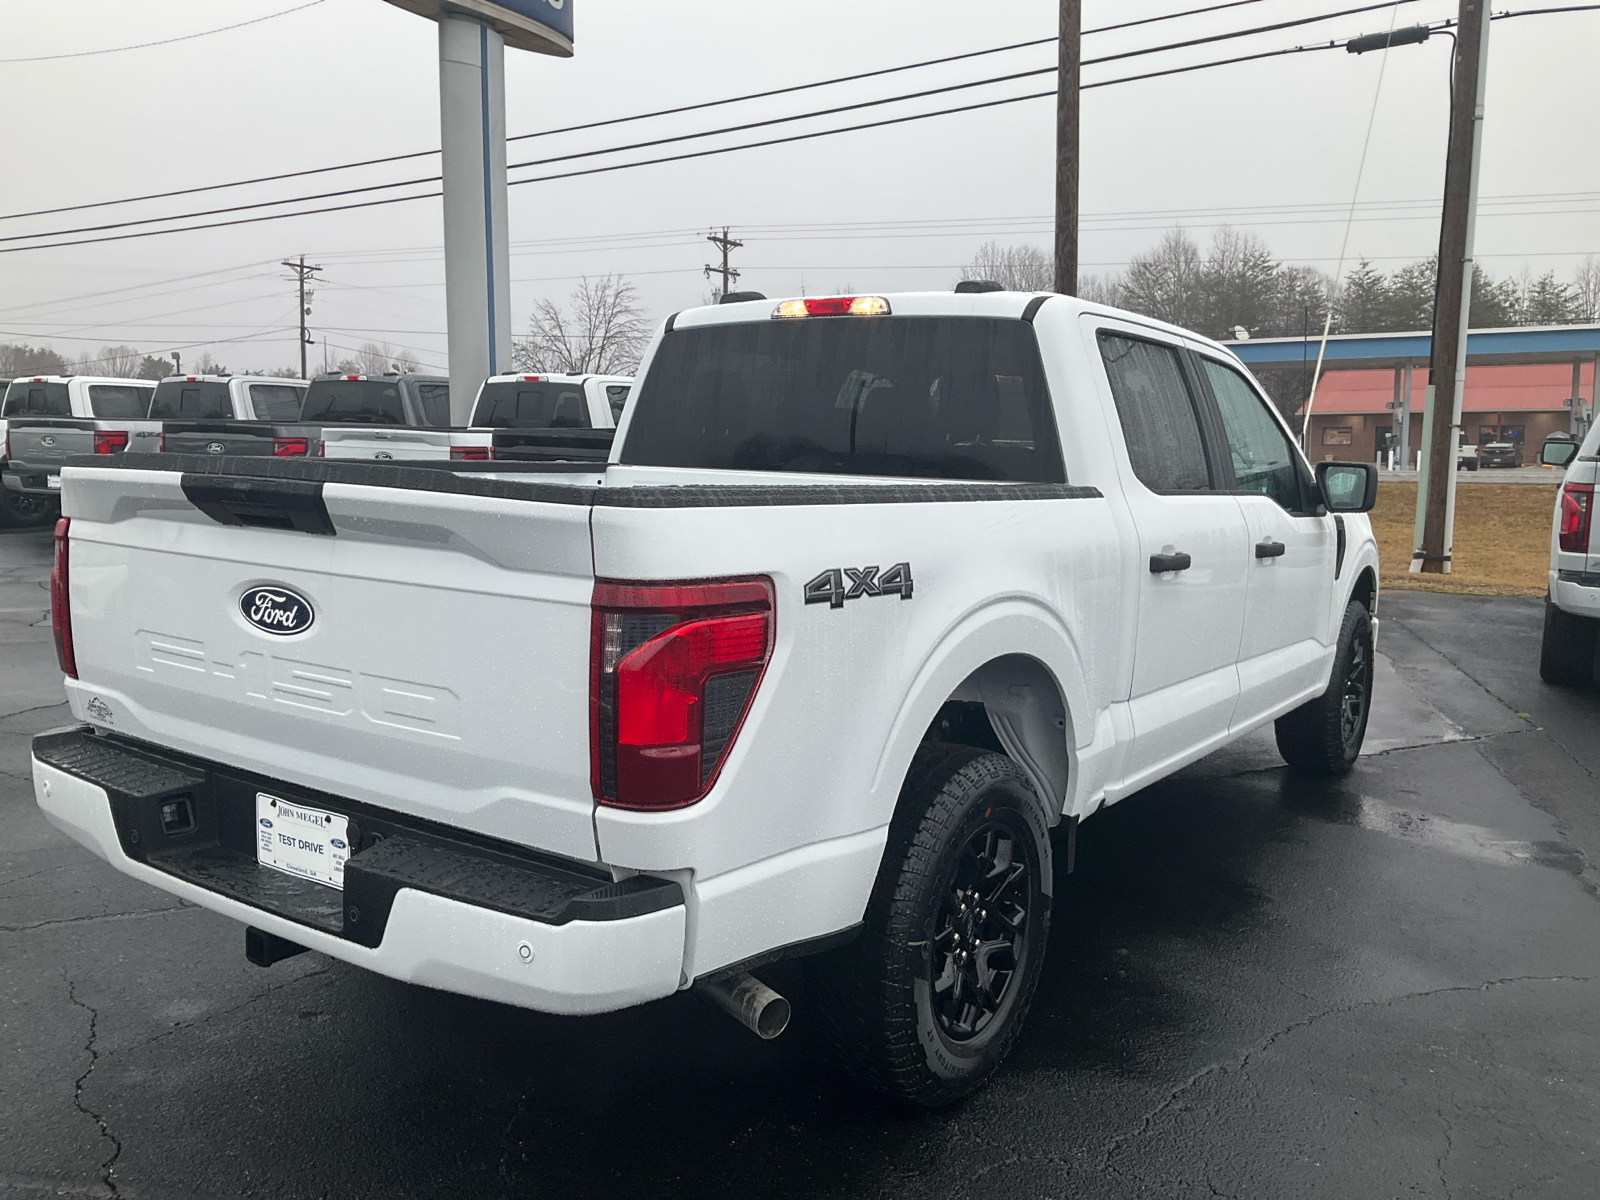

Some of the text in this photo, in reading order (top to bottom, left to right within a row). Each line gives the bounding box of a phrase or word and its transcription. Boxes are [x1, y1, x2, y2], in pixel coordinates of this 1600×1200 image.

[251, 591, 298, 628] Ford
[277, 805, 326, 828] JOHN MEGEL
[277, 833, 297, 848] TEST
[298, 839, 325, 855] DRIVE
[310, 869, 317, 877] GA
